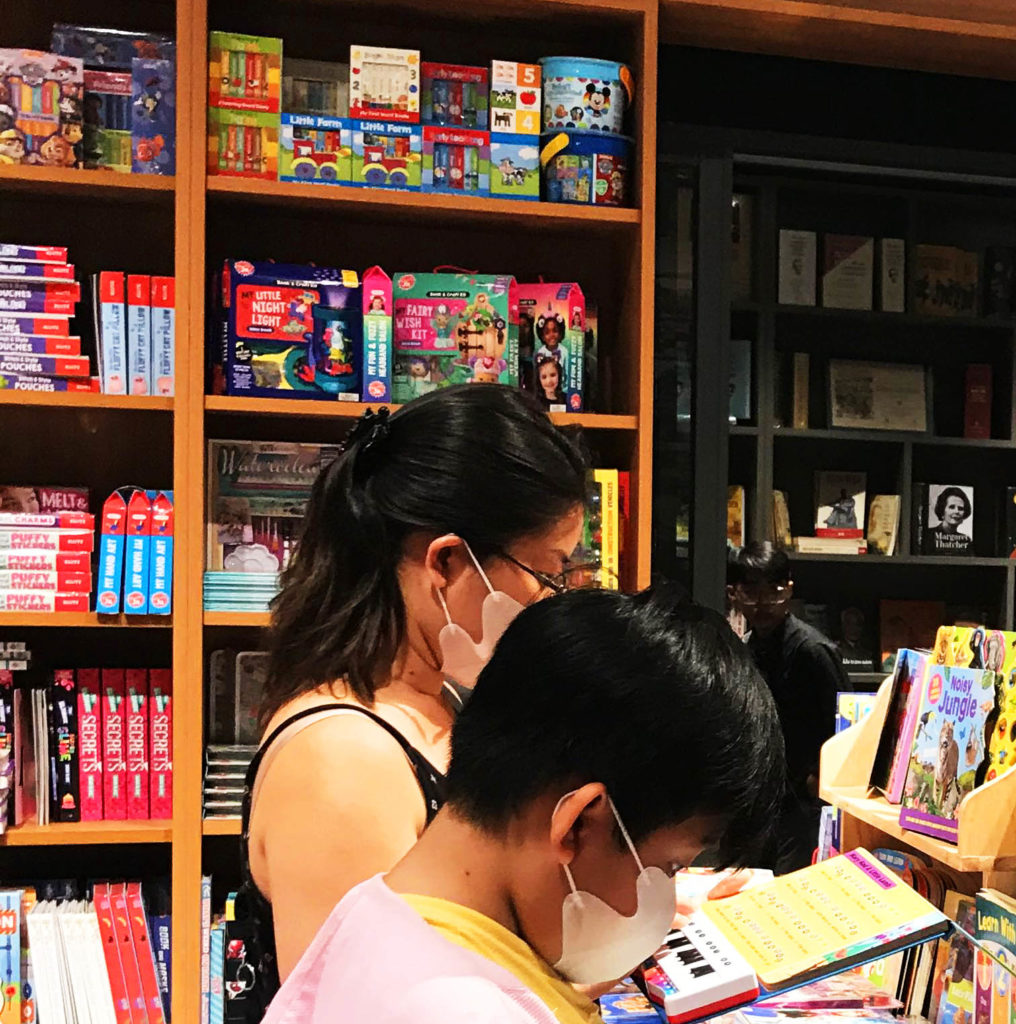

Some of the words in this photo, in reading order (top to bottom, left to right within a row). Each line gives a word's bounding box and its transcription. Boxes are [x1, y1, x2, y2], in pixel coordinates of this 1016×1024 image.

[523, 68, 535, 84] 5
[290, 115, 315, 126] Little
[317, 118, 343, 129] Farm
[360, 121, 385, 132] Little
[387, 123, 412, 134] Farm
[522, 116, 534, 130] 4
[255, 290, 282, 300] LITTLE
[252, 302, 286, 313] NIGHT
[406, 304, 434, 317] FAIRY
[251, 313, 282, 327] LIGHT
[395, 317, 422, 329] WISH
[411, 329, 428, 340] KIT
[1, 362, 43, 372] POUCHES
[14, 382, 55, 392] POUCHES
[42, 491, 75, 508] MELT
[76, 498, 87, 508] &
[11, 533, 49, 542] PUFFY
[935, 532, 969, 541] Margaret
[11, 542, 56, 550] STICKERS
[935, 541, 969, 549] Thatcher
[8, 554, 47, 563] PUFFY
[11, 573, 49, 582] PUFFY
[11, 582, 56, 590] STICKERS
[6, 594, 45, 603] PUFFY
[6, 603, 52, 611] STICKERS
[950, 675, 973, 696] Noisy
[938, 693, 978, 722] Jungle
[81, 715, 97, 772] SECRETS
[106, 715, 123, 772] SECRETS
[129, 715, 146, 772] SECRETS
[153, 714, 170, 772] SECRETS
[977, 911, 999, 935] Learn
[1000, 919, 1016, 944] With
